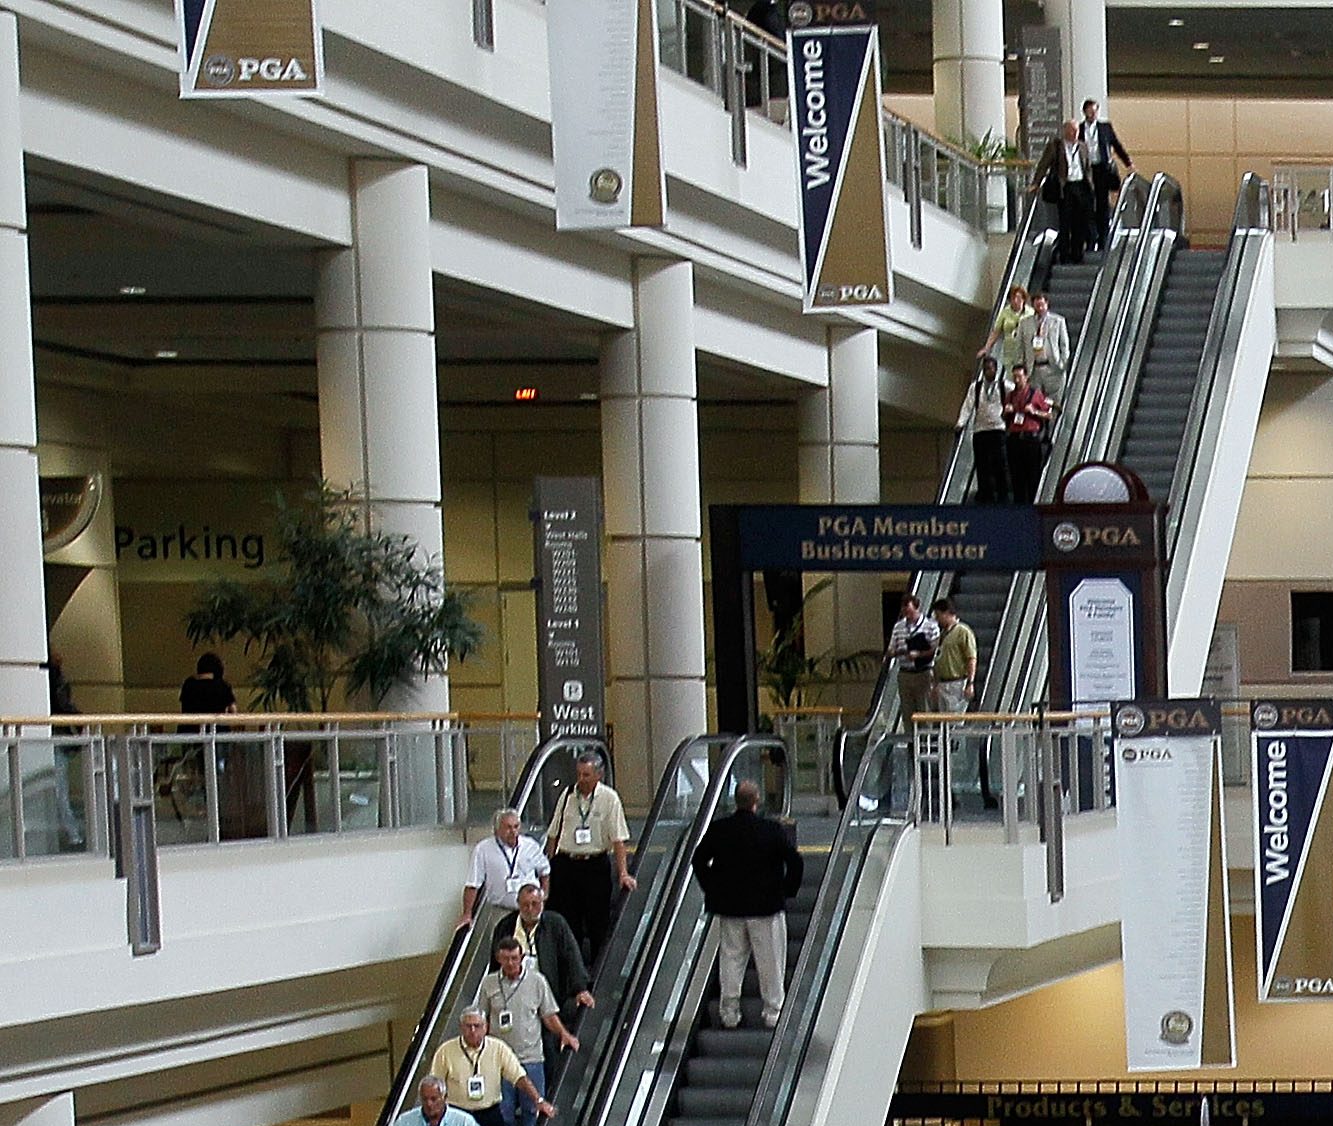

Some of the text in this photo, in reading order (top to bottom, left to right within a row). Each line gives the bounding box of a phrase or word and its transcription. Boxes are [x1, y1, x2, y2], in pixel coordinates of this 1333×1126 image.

[238, 57, 308, 81] PGA
[802, 38, 831, 190] Welcome
[837, 285, 882, 301] PGA
[818, 516, 970, 537] PGA Member
[1083, 527, 1141, 547] PGA
[114, 524, 265, 570] Parking
[801, 539, 988, 561] Business Center
[553, 704, 595, 721] West
[1149, 709, 1210, 730] PGA
[1279, 707, 1331, 725] PGA
[1139, 750, 1172, 761] PGA
[1263, 740, 1290, 886] Welcome
[987, 1094, 1106, 1119] Products
[1118, 1096, 1142, 1117] &
